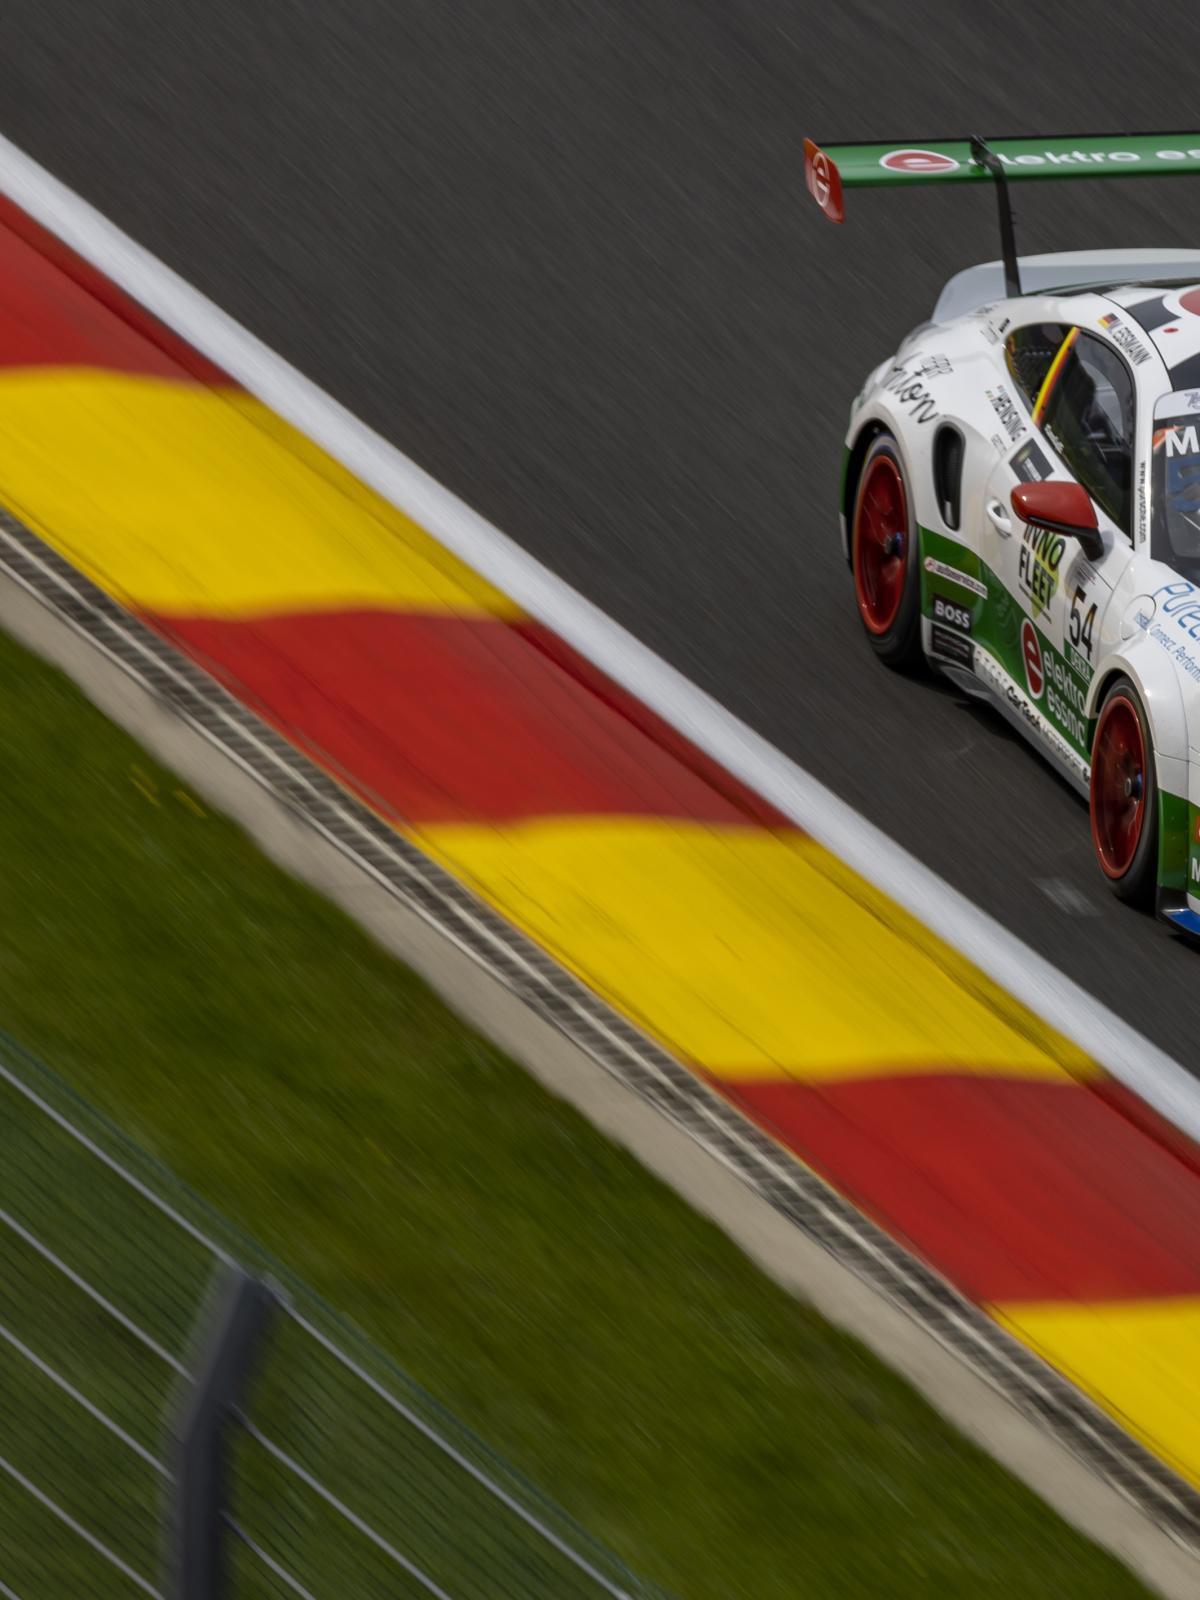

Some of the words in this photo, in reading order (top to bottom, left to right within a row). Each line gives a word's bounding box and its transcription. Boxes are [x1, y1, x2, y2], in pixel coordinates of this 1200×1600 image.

[1018, 544, 1056, 611] FLEET
[934, 599, 970, 629] BOSS
[1069, 584, 1099, 662] 54
